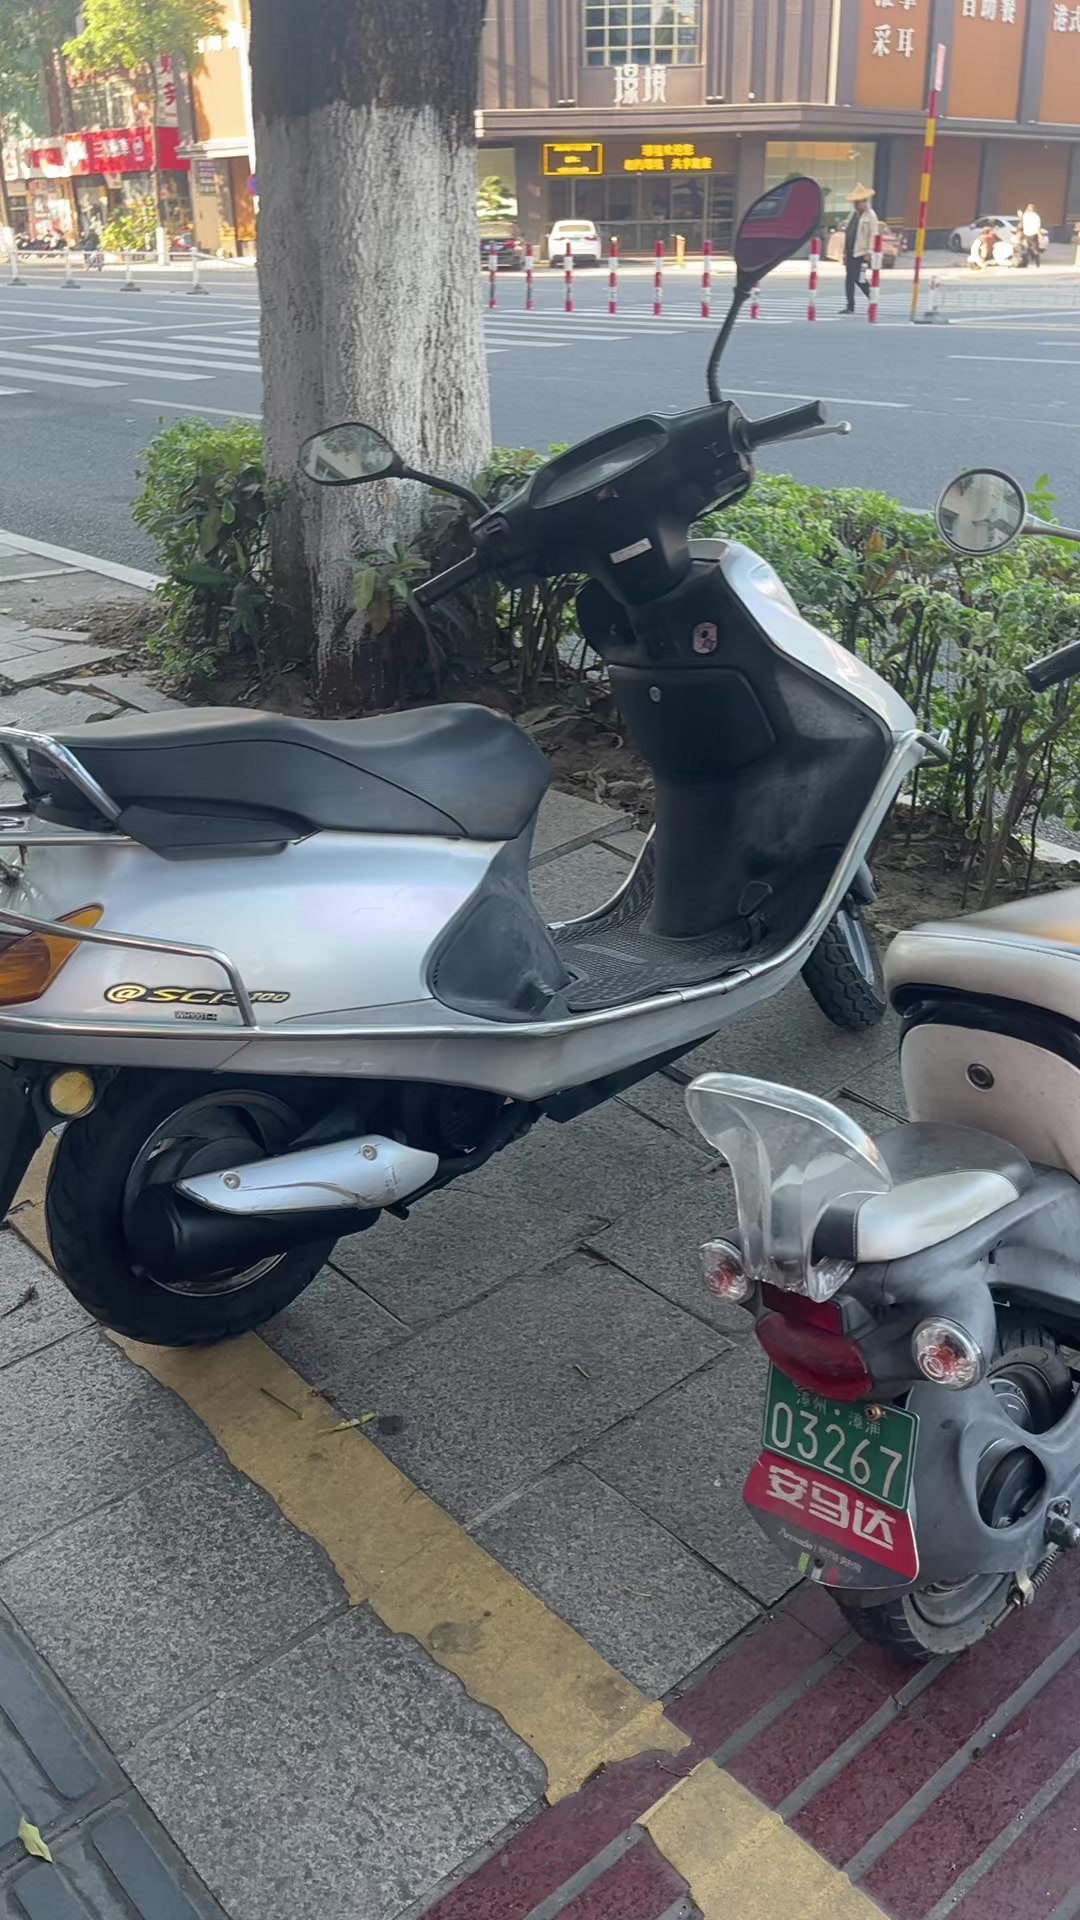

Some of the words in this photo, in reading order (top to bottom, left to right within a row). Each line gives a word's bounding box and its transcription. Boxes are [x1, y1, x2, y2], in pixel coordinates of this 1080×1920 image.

[872, 24, 916, 57] 采耳
[771, 1401, 903, 1498] 03267
[766, 1464, 897, 1551] 安马达
